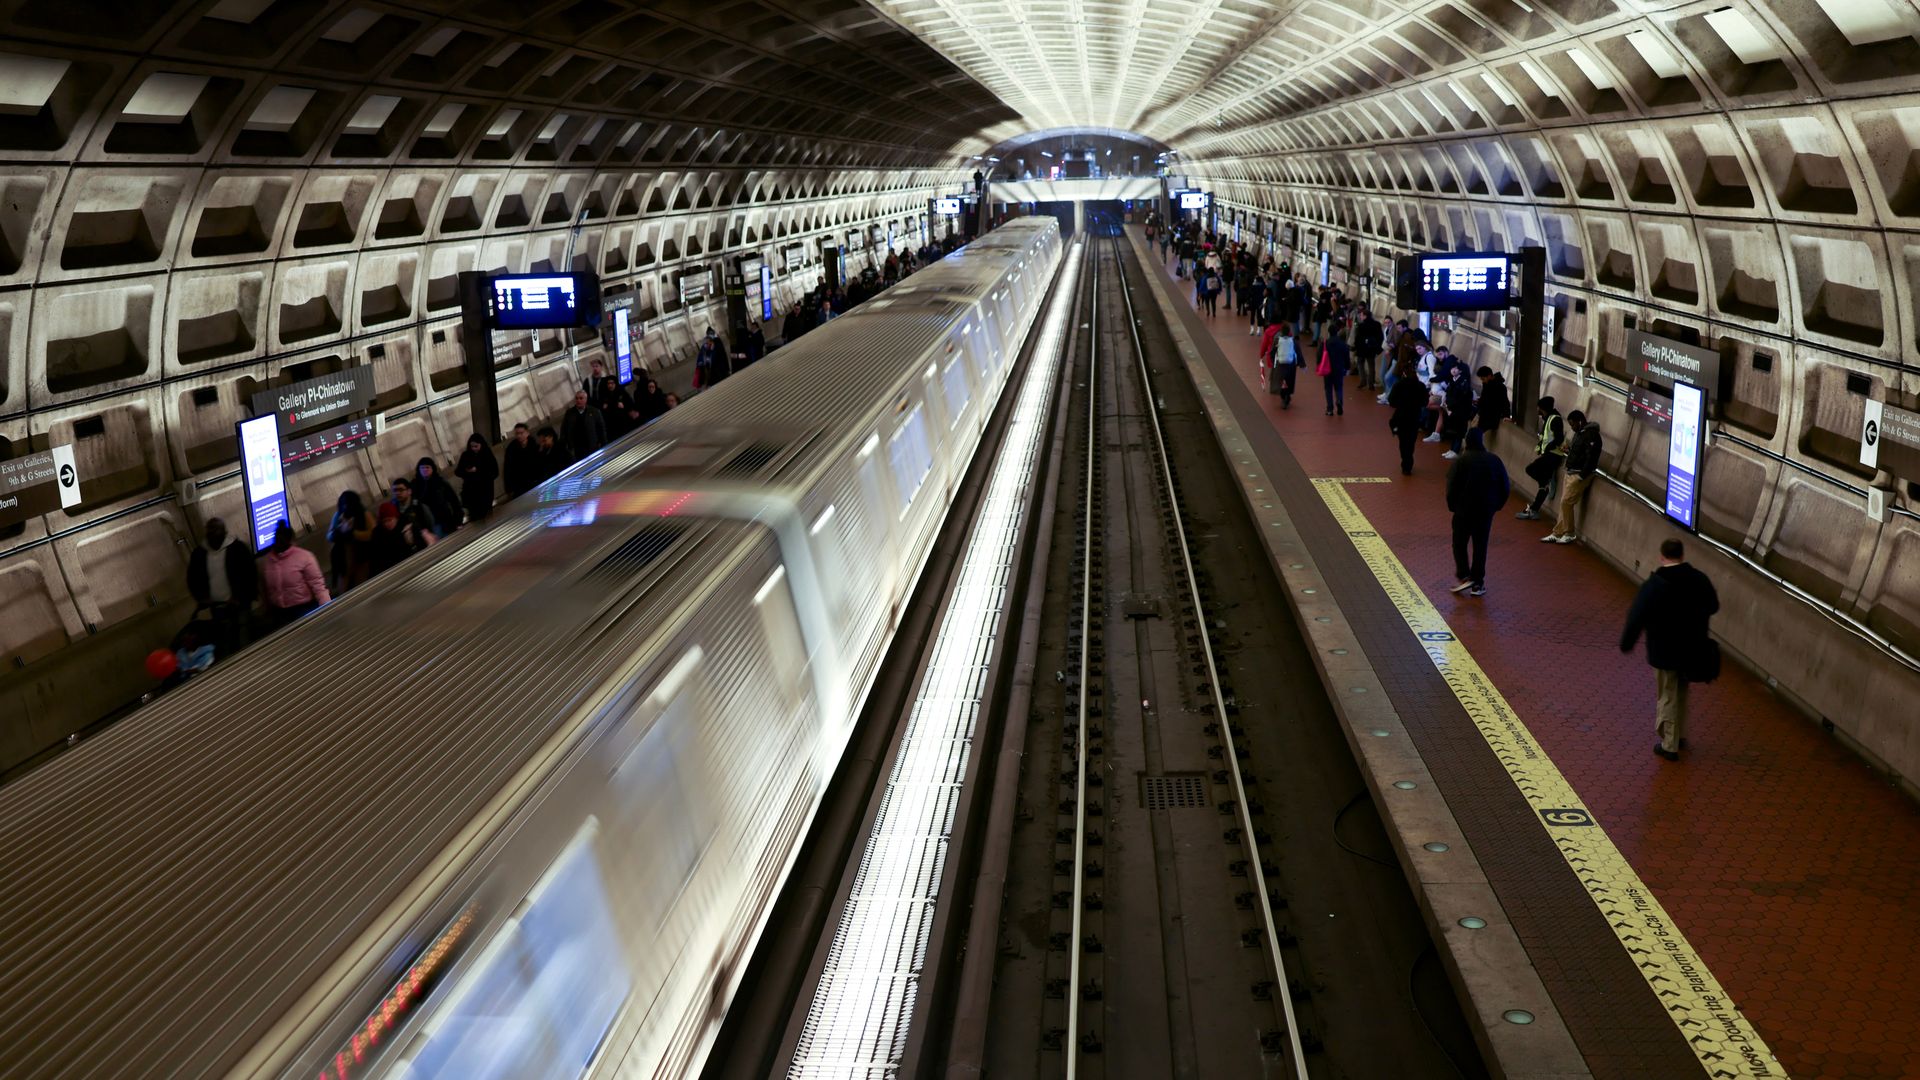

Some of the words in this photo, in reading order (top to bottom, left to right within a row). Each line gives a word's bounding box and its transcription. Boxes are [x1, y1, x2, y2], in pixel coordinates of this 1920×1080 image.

[1641, 341, 1661, 363] Gallery
[278, 393, 306, 410] Gallery
[1884, 408, 1894, 420] Exit
[1896, 427, 1902, 437] G
[1, 463, 16, 474] Exit
[24, 455, 53, 468] Galleries,
[8, 476, 20, 486] 9th
[20, 474, 26, 483] &
[27, 471, 34, 481] G
[34, 468, 55, 478] Streets
[1546, 811, 1589, 824] 6
[1625, 887, 1652, 913] Trains
[1644, 914, 1670, 937] 6-Car
[1661, 938, 1681, 952] for
[1672, 953, 1711, 993] Platform
[1702, 994, 1723, 1011] the
[1715, 1013, 1747, 1043] Down
[1739, 1045, 1773, 1078] Move
